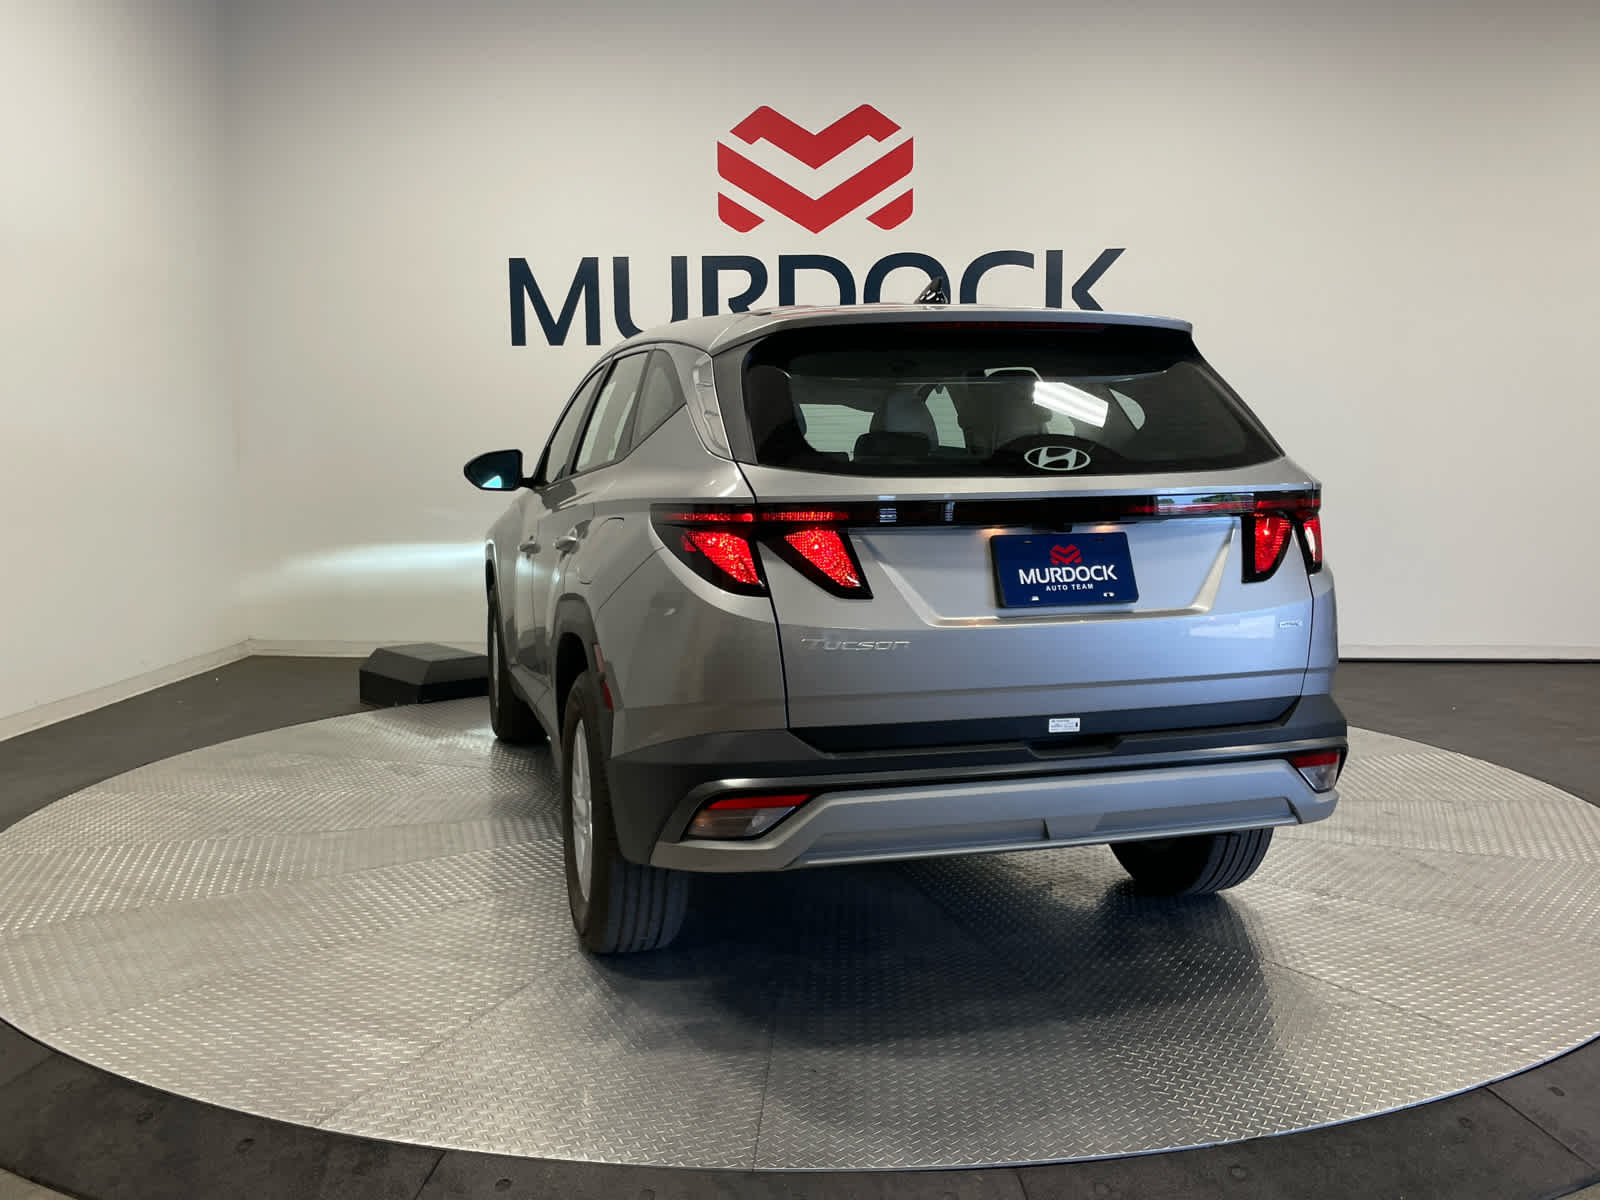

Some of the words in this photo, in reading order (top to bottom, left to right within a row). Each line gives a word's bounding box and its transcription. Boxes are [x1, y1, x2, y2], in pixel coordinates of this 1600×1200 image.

[508, 248, 1126, 346] MURDOCK
[1018, 564, 1117, 584] MURDOCK
[1045, 584, 1068, 592] AUTO
